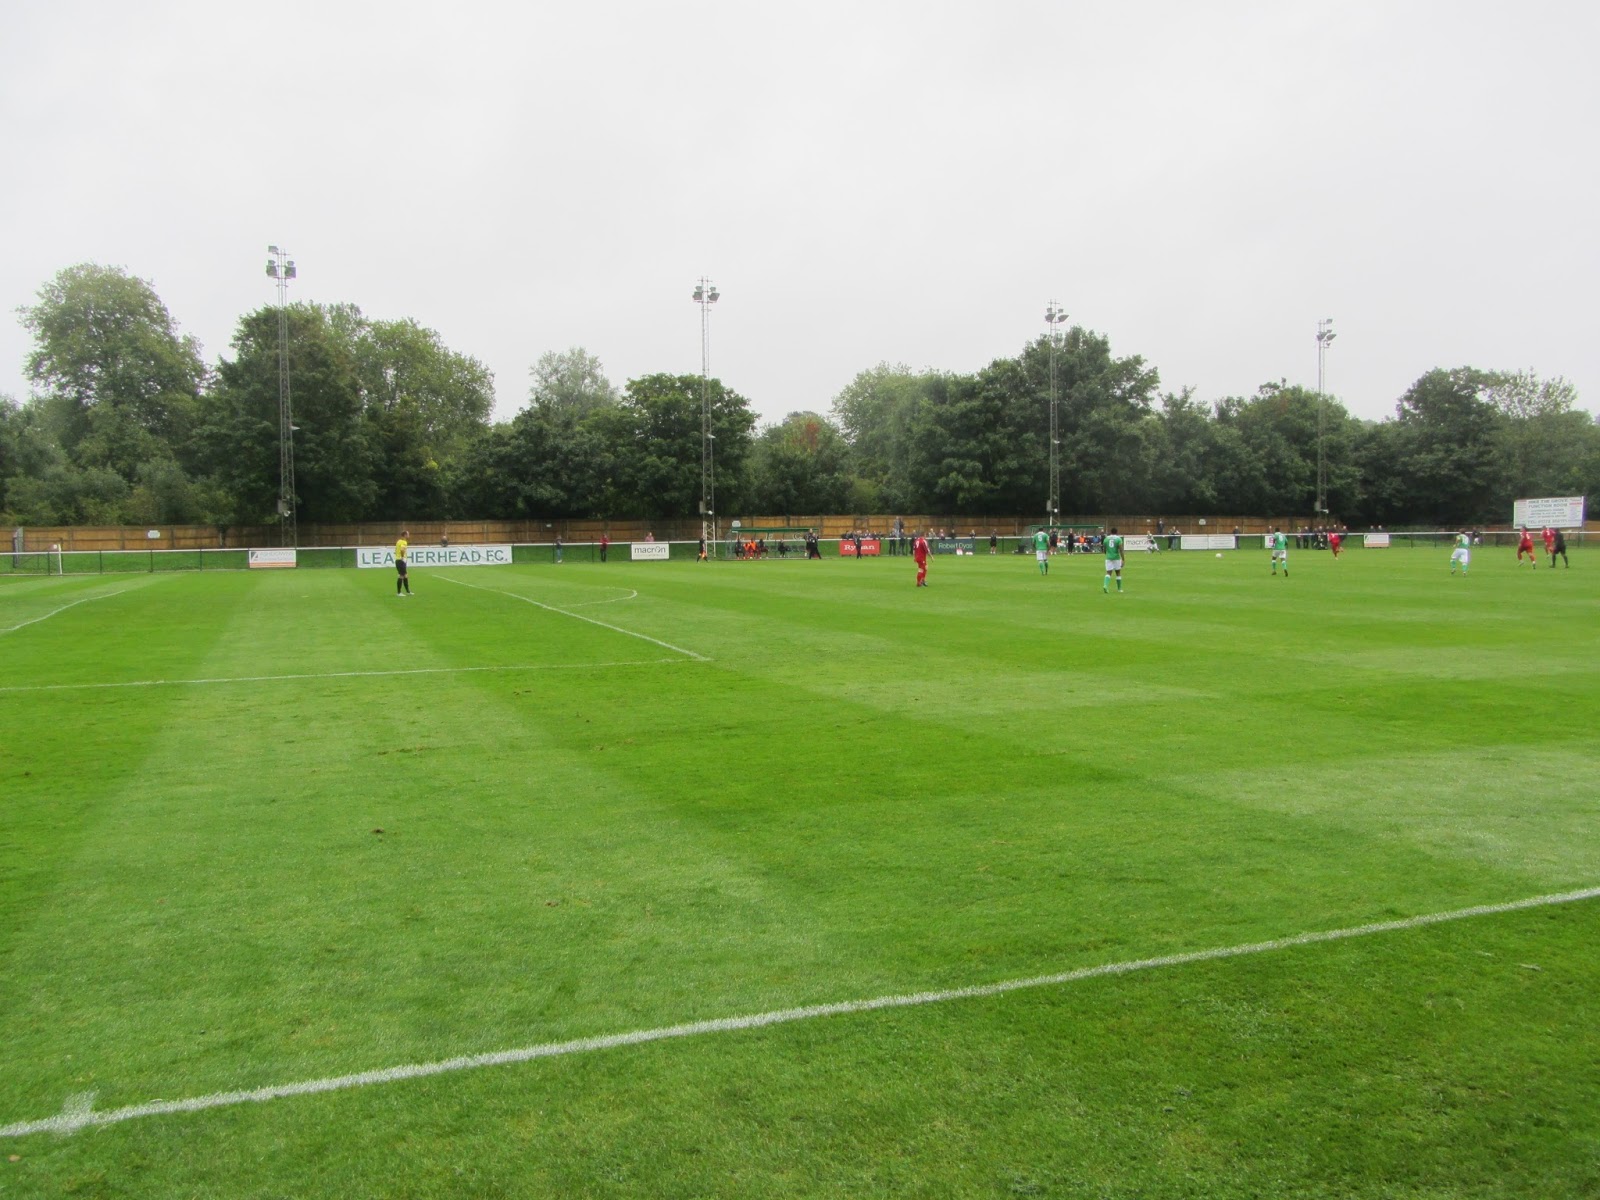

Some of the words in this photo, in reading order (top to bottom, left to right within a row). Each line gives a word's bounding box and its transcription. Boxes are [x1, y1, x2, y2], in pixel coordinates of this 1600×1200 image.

[634, 546, 666, 554] macron
[958, 542, 973, 550] Dyas
[362, 550, 481, 565] LEAHERHEAD
